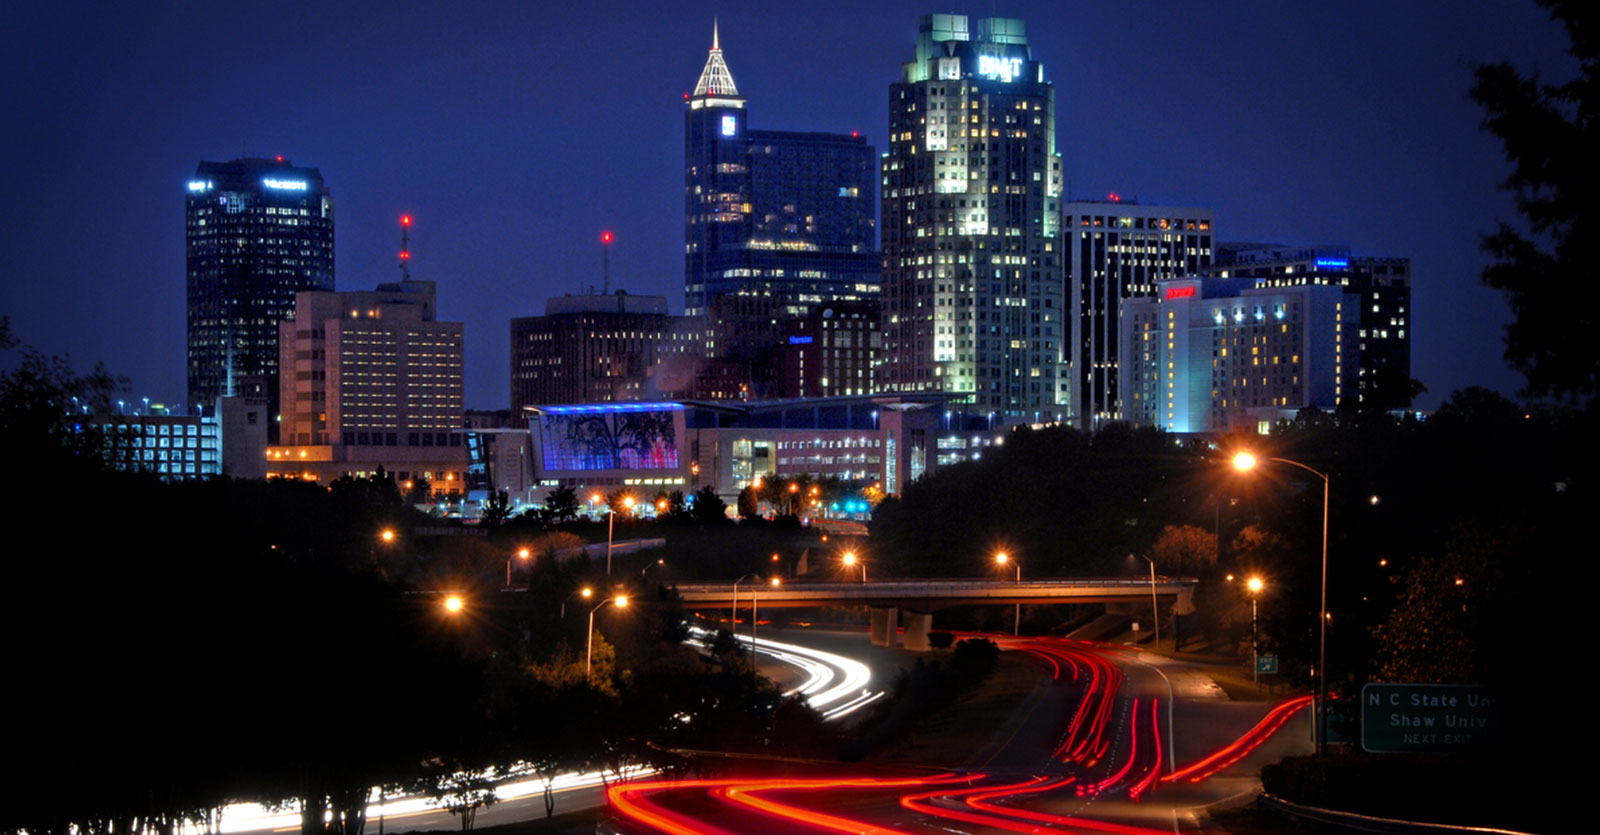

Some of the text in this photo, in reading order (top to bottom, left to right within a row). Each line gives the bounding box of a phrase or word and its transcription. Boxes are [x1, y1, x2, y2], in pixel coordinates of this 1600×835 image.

[1369, 693, 1496, 708] N C State Un
[1390, 713, 1435, 727] Shaw
[1403, 733, 1473, 745] NEXT EXIT
